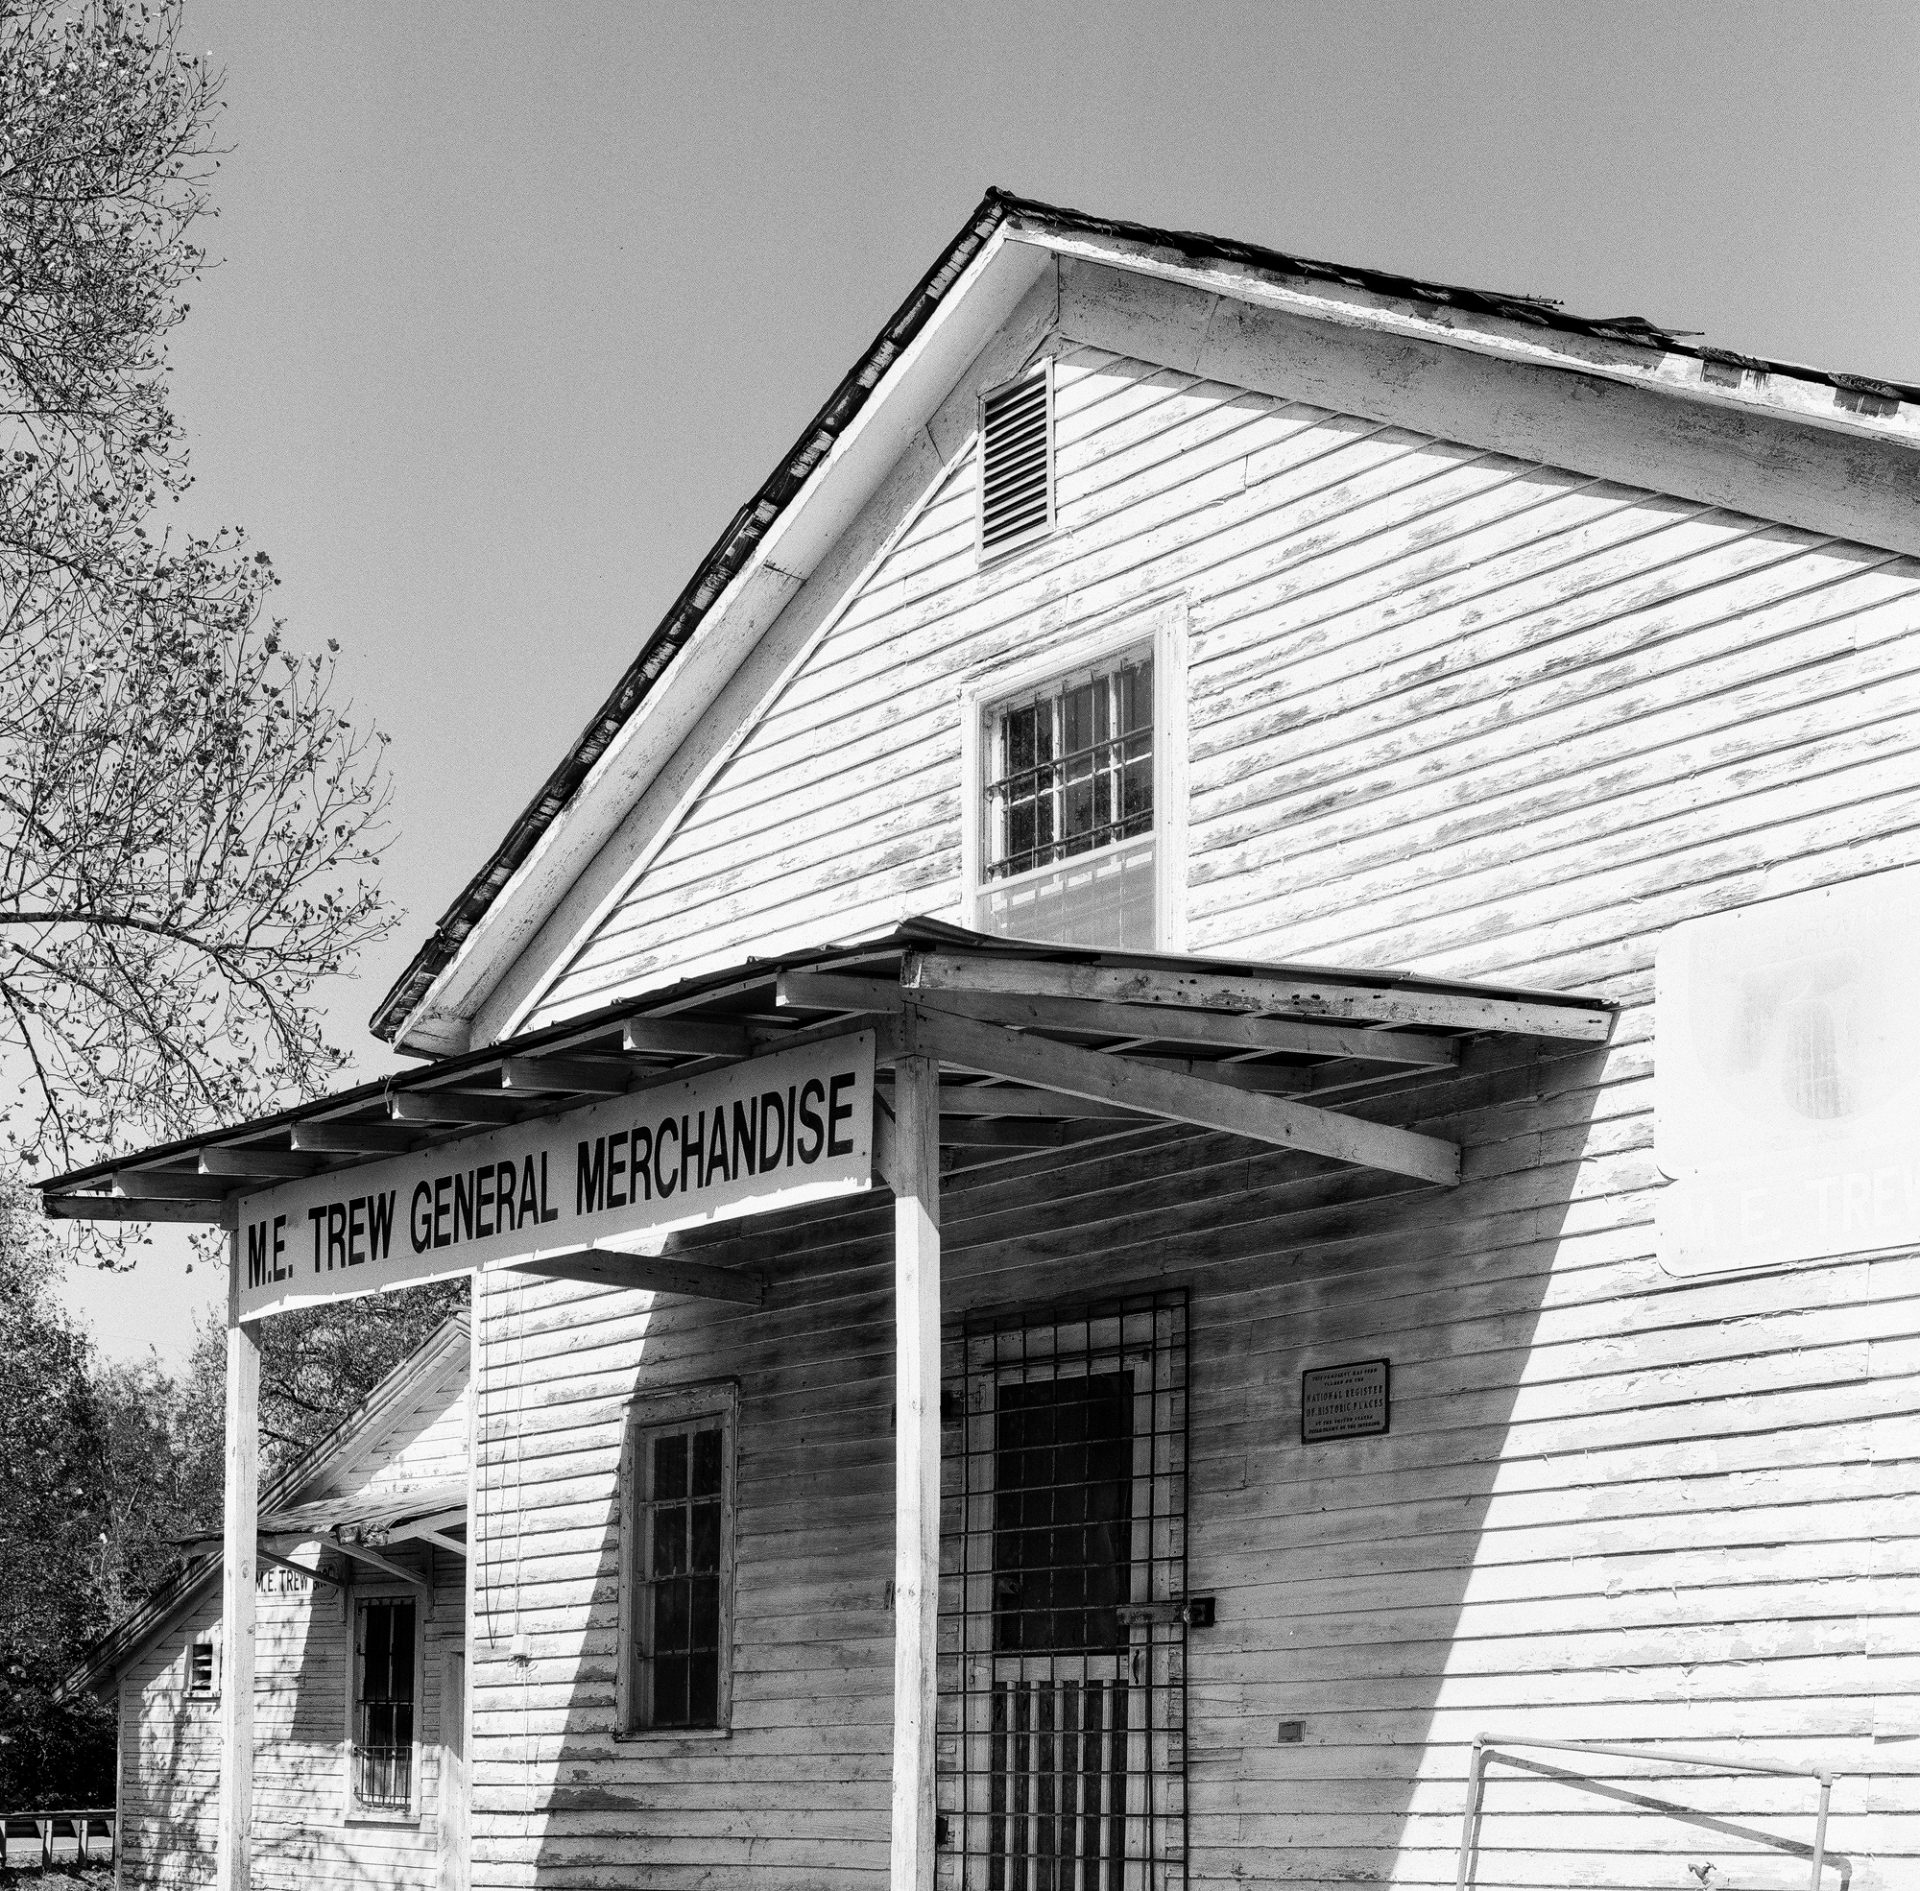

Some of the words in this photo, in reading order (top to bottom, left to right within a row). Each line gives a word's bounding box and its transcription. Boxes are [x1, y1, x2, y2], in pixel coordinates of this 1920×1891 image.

[247, 1213, 293, 1289] M.E.
[308, 1190, 397, 1273] TREW
[410, 1150, 558, 1255] GENERAL
[576, 1072, 856, 1216] MERCHANDISE
[1306, 1390, 1342, 1402] NATIONAL
[1345, 1385, 1383, 1398] REGISTER
[1317, 1402, 1351, 1416] HISTORIC
[1353, 1399, 1383, 1410] PLACES
[279, 1570, 308, 1591] TREW
